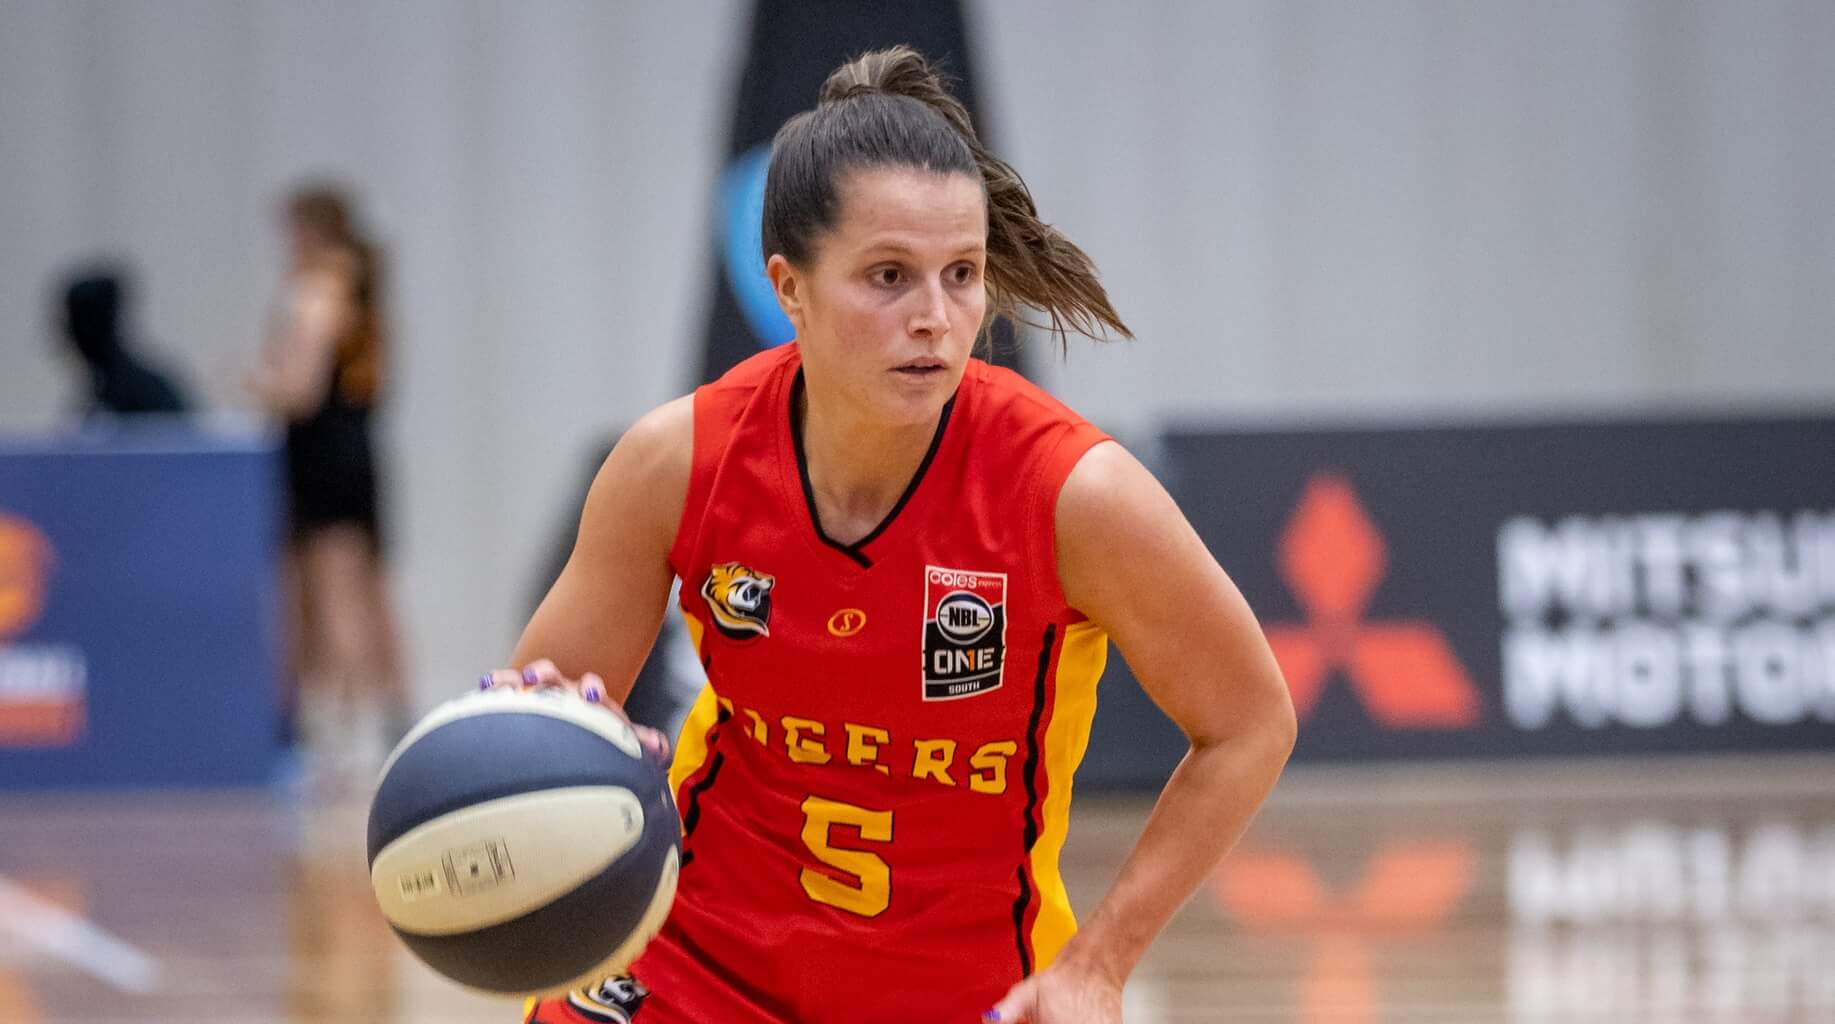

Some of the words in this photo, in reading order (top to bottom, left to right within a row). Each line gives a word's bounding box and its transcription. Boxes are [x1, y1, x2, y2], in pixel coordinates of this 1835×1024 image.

[1498, 511, 1835, 612] MITSU
[929, 571, 977, 588] coles
[948, 605, 980, 627] NBL
[949, 681, 980, 694] SOUTH
[800, 795, 894, 917] 5
